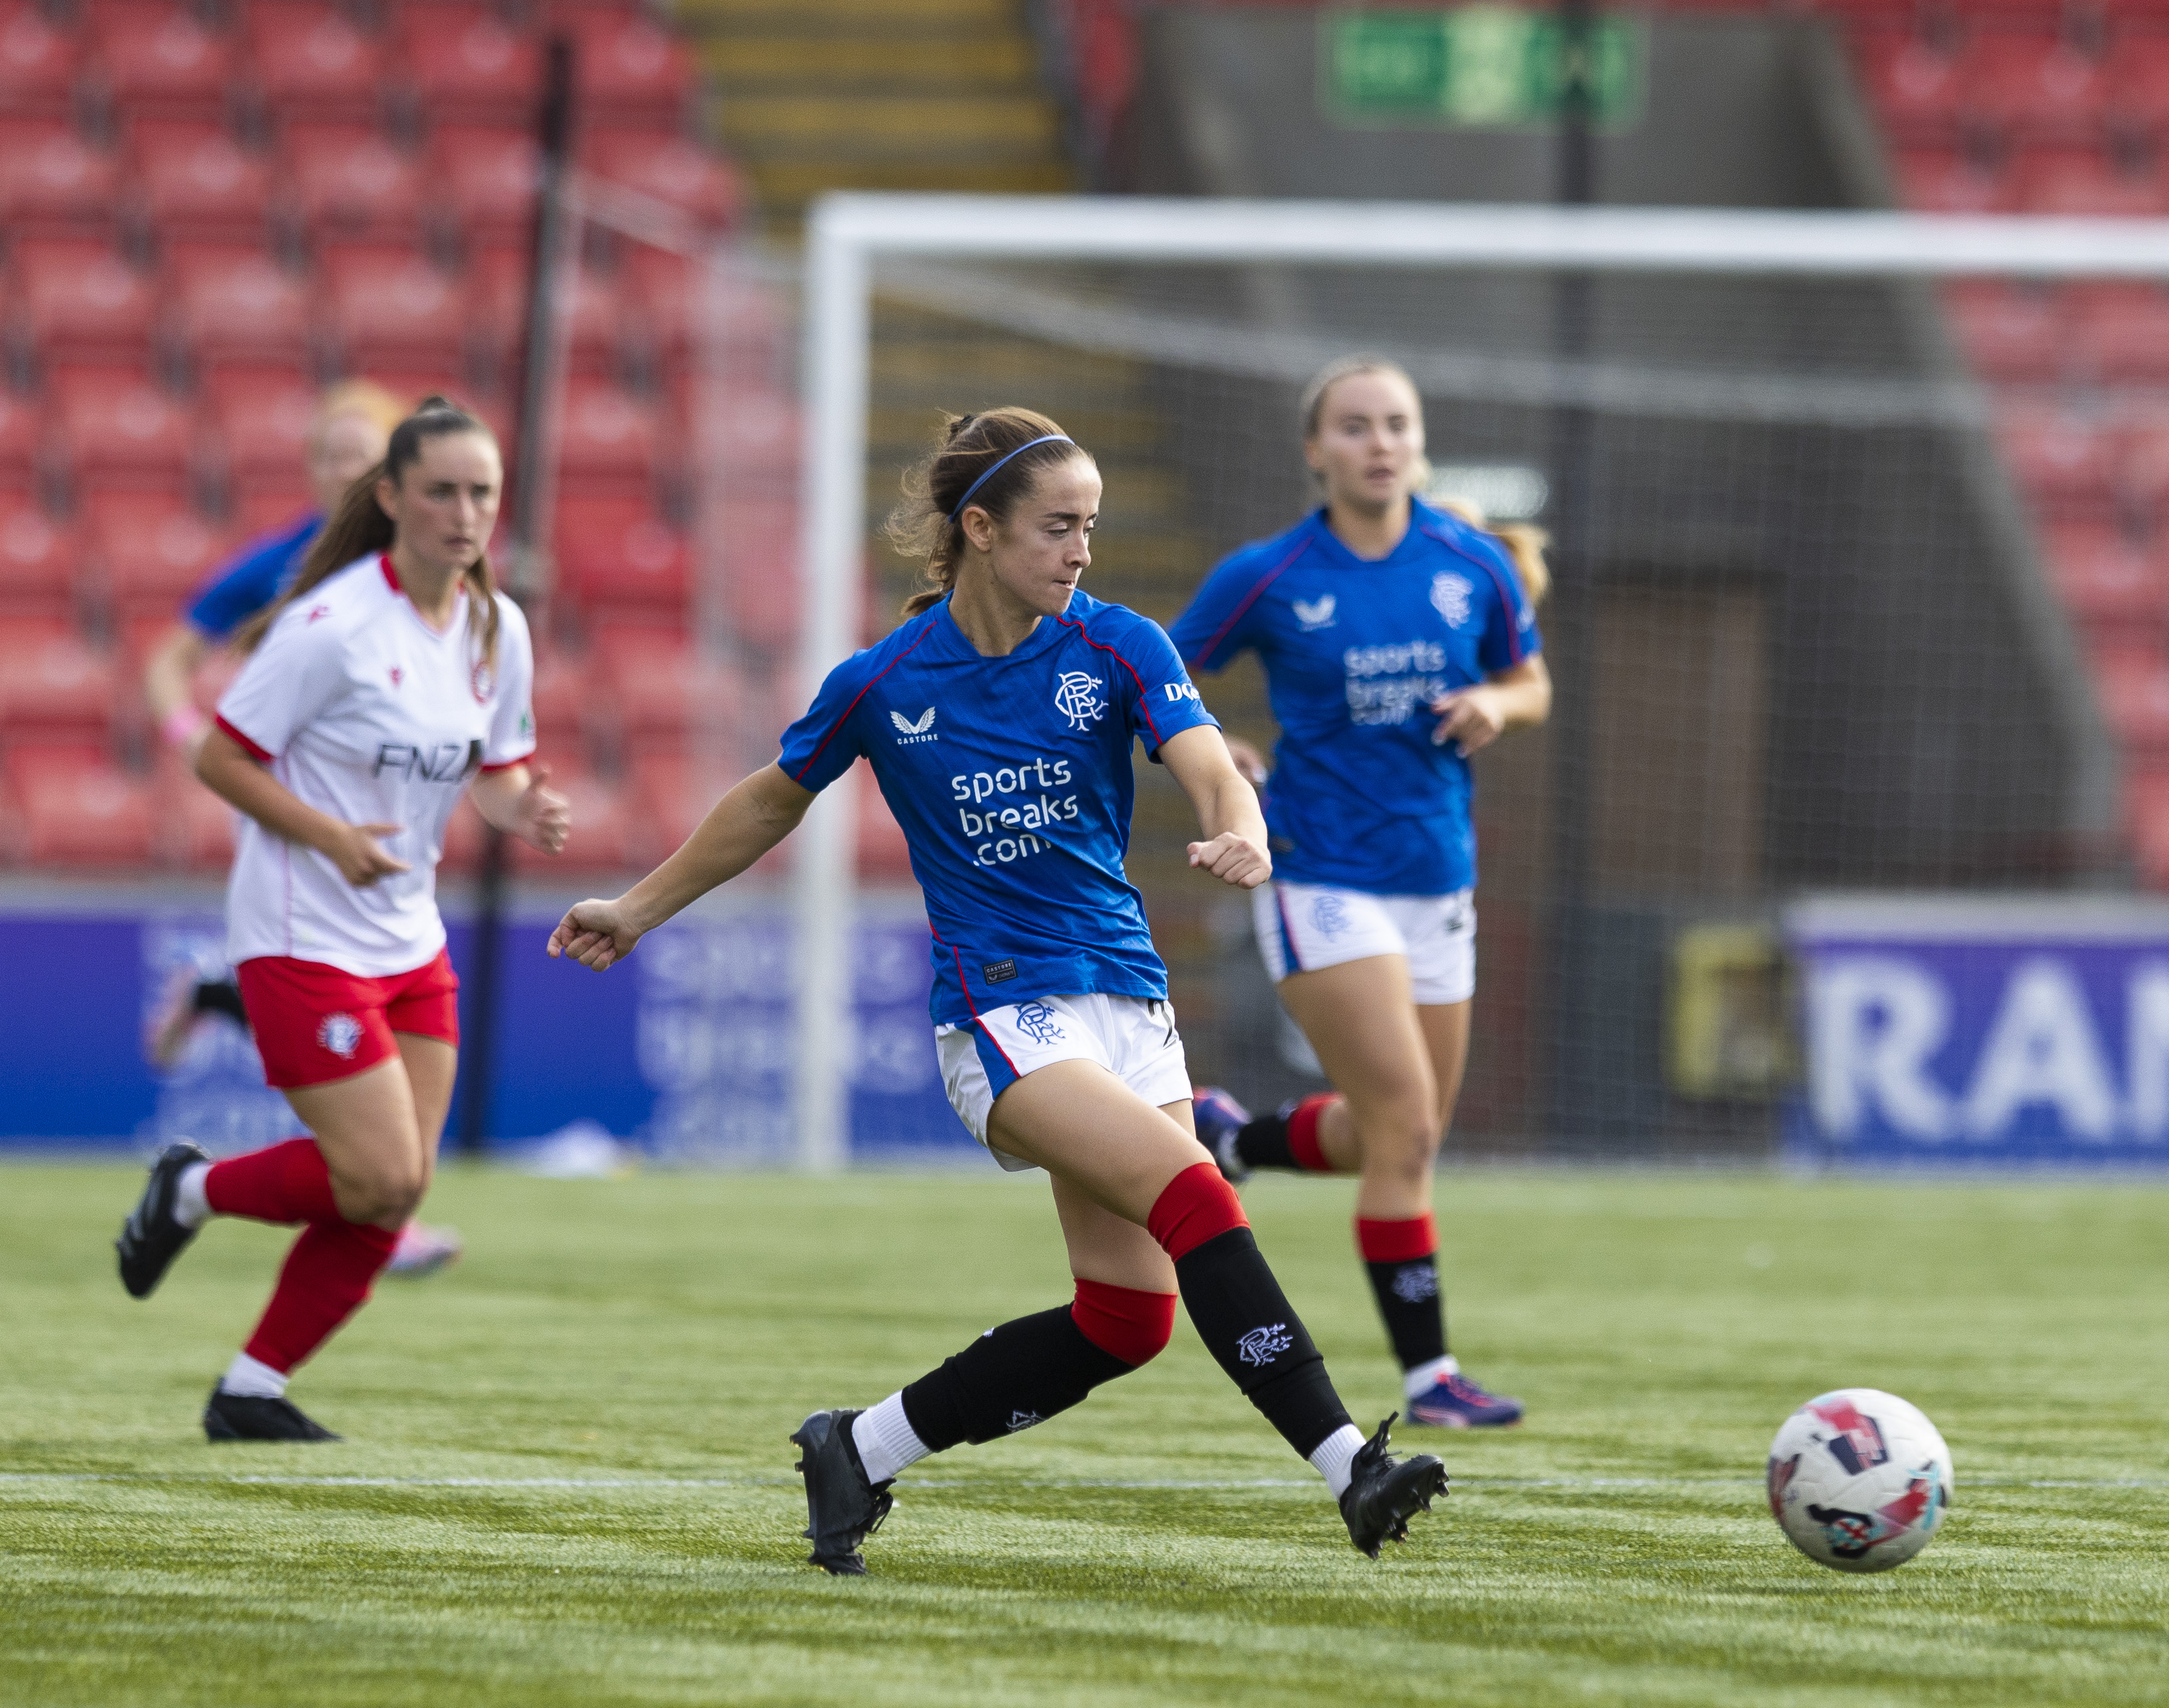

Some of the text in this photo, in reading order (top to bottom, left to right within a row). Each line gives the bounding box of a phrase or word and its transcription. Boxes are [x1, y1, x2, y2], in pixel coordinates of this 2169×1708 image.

[897, 733, 938, 745] CASTORE
[951, 757, 1071, 803] sports
[959, 794, 1078, 837] breaks
